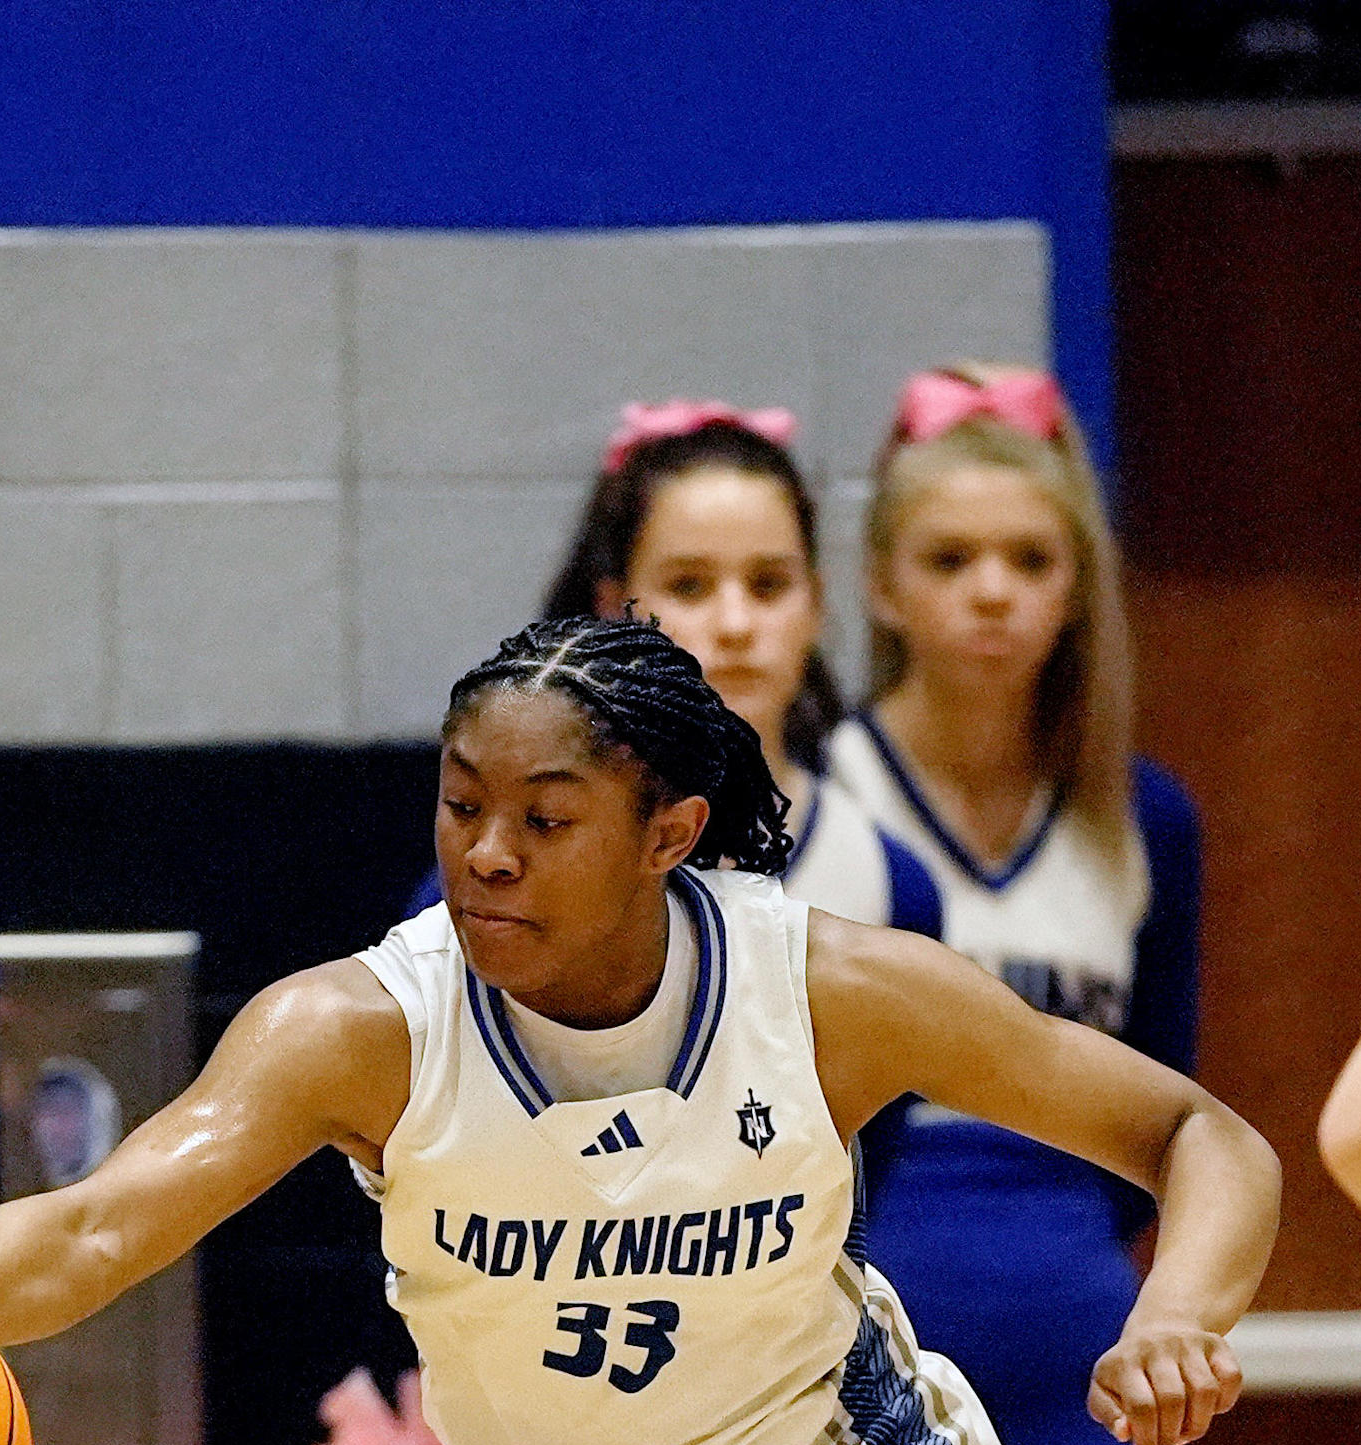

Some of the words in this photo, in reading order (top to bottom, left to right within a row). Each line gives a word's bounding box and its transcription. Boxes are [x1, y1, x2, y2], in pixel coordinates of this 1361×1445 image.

[434, 1208, 567, 1281] LADY
[573, 1193, 804, 1280] KNIGHTS
[542, 1300, 680, 1394] 33
